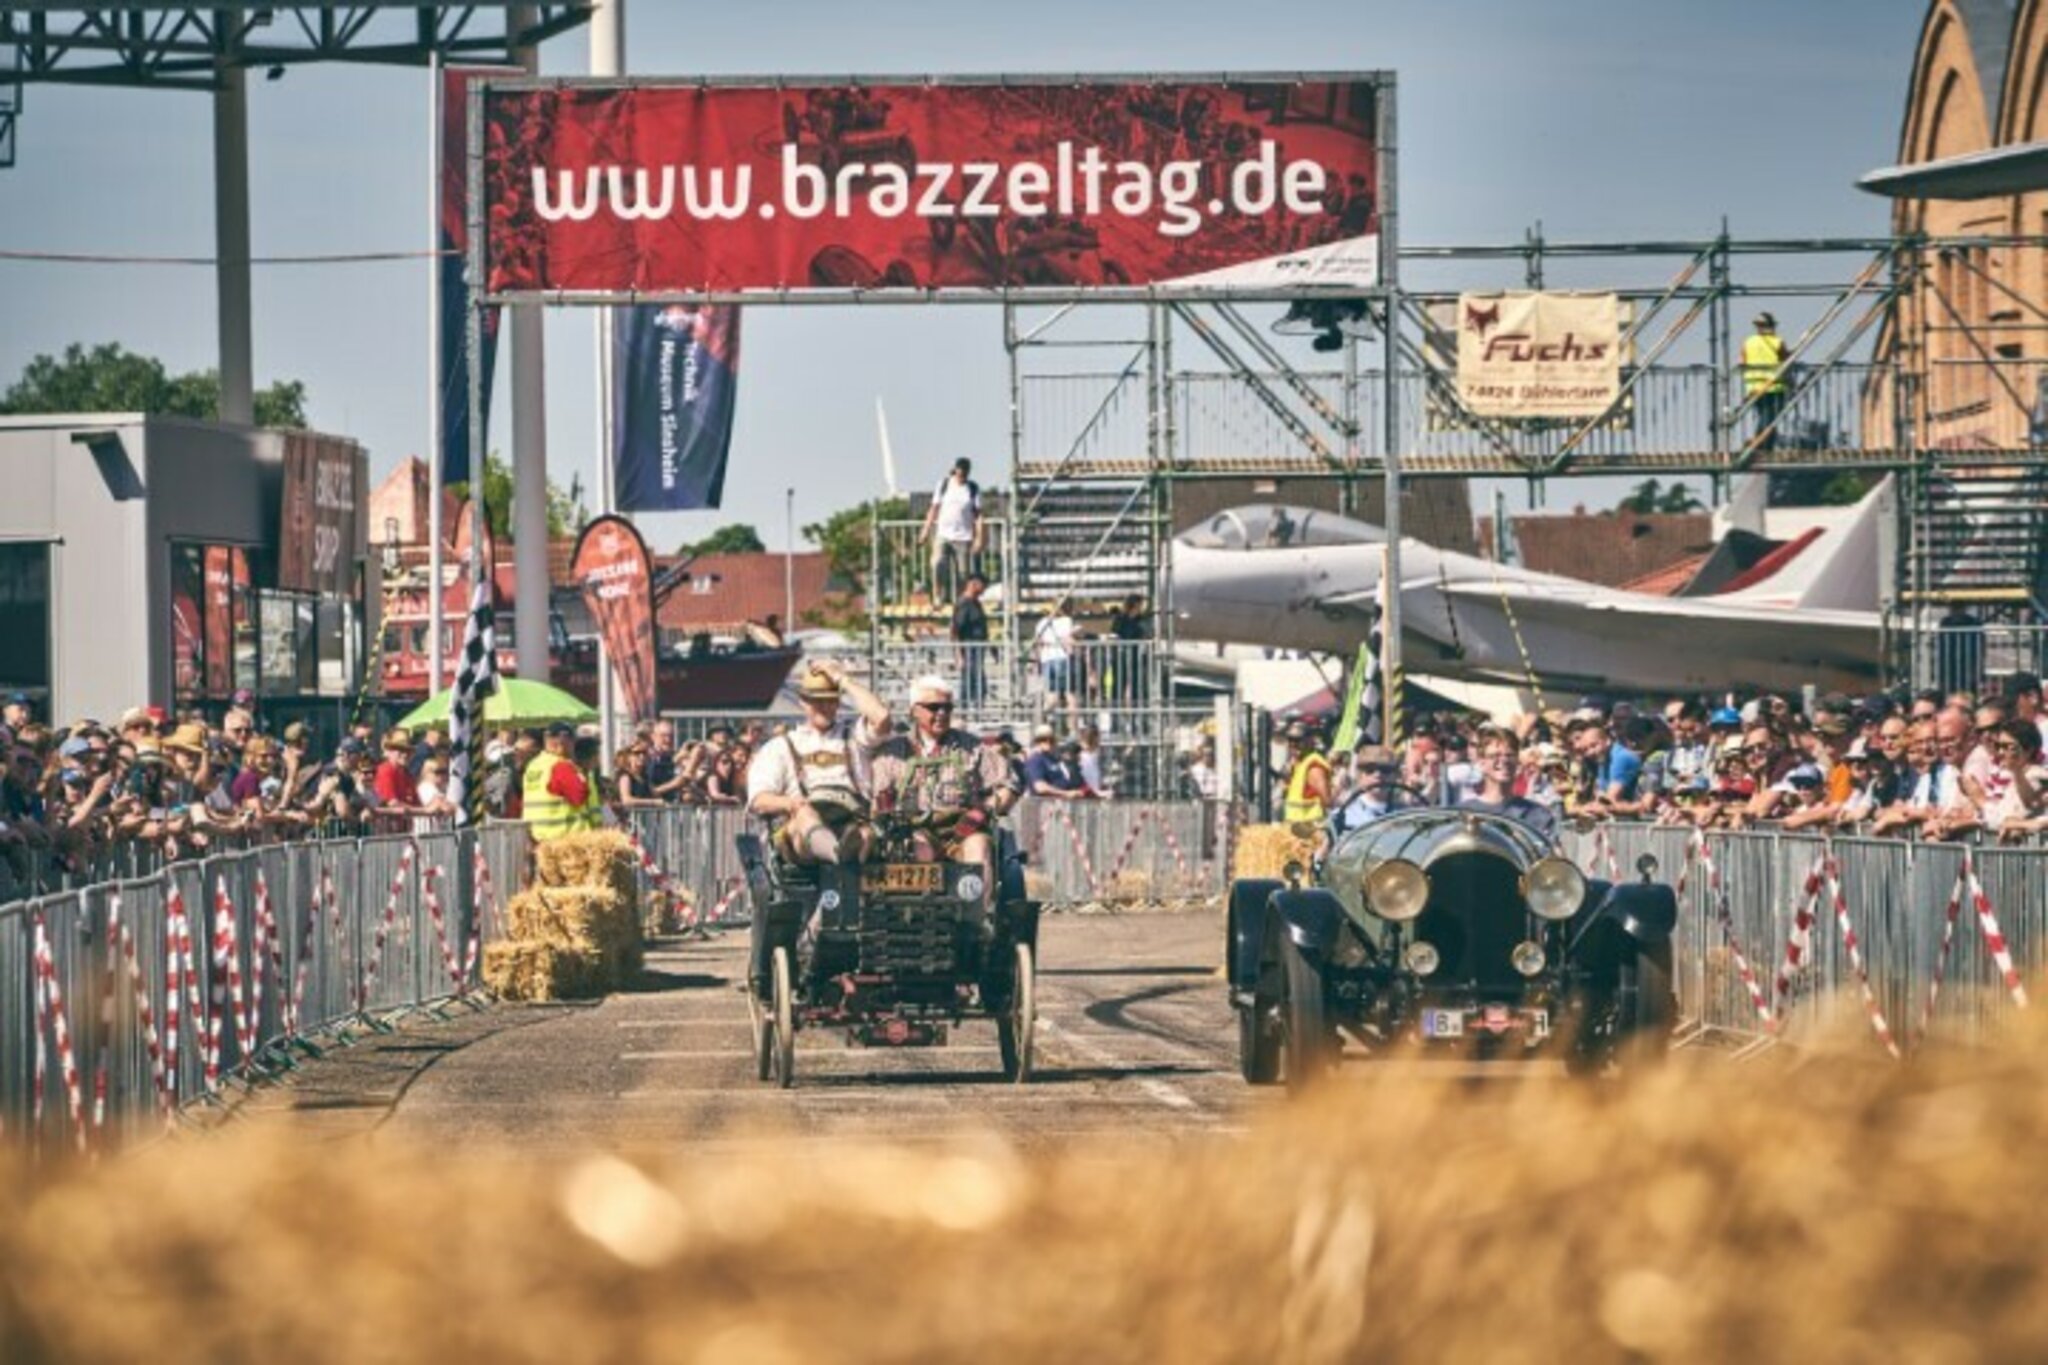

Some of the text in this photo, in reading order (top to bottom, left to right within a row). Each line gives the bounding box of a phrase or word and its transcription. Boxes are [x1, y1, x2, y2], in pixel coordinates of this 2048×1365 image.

[531, 140, 1326, 237] www.brazzeltag.de
[1482, 332, 1609, 362] Fuchs
[660, 340, 679, 490] Museum Sinsheim
